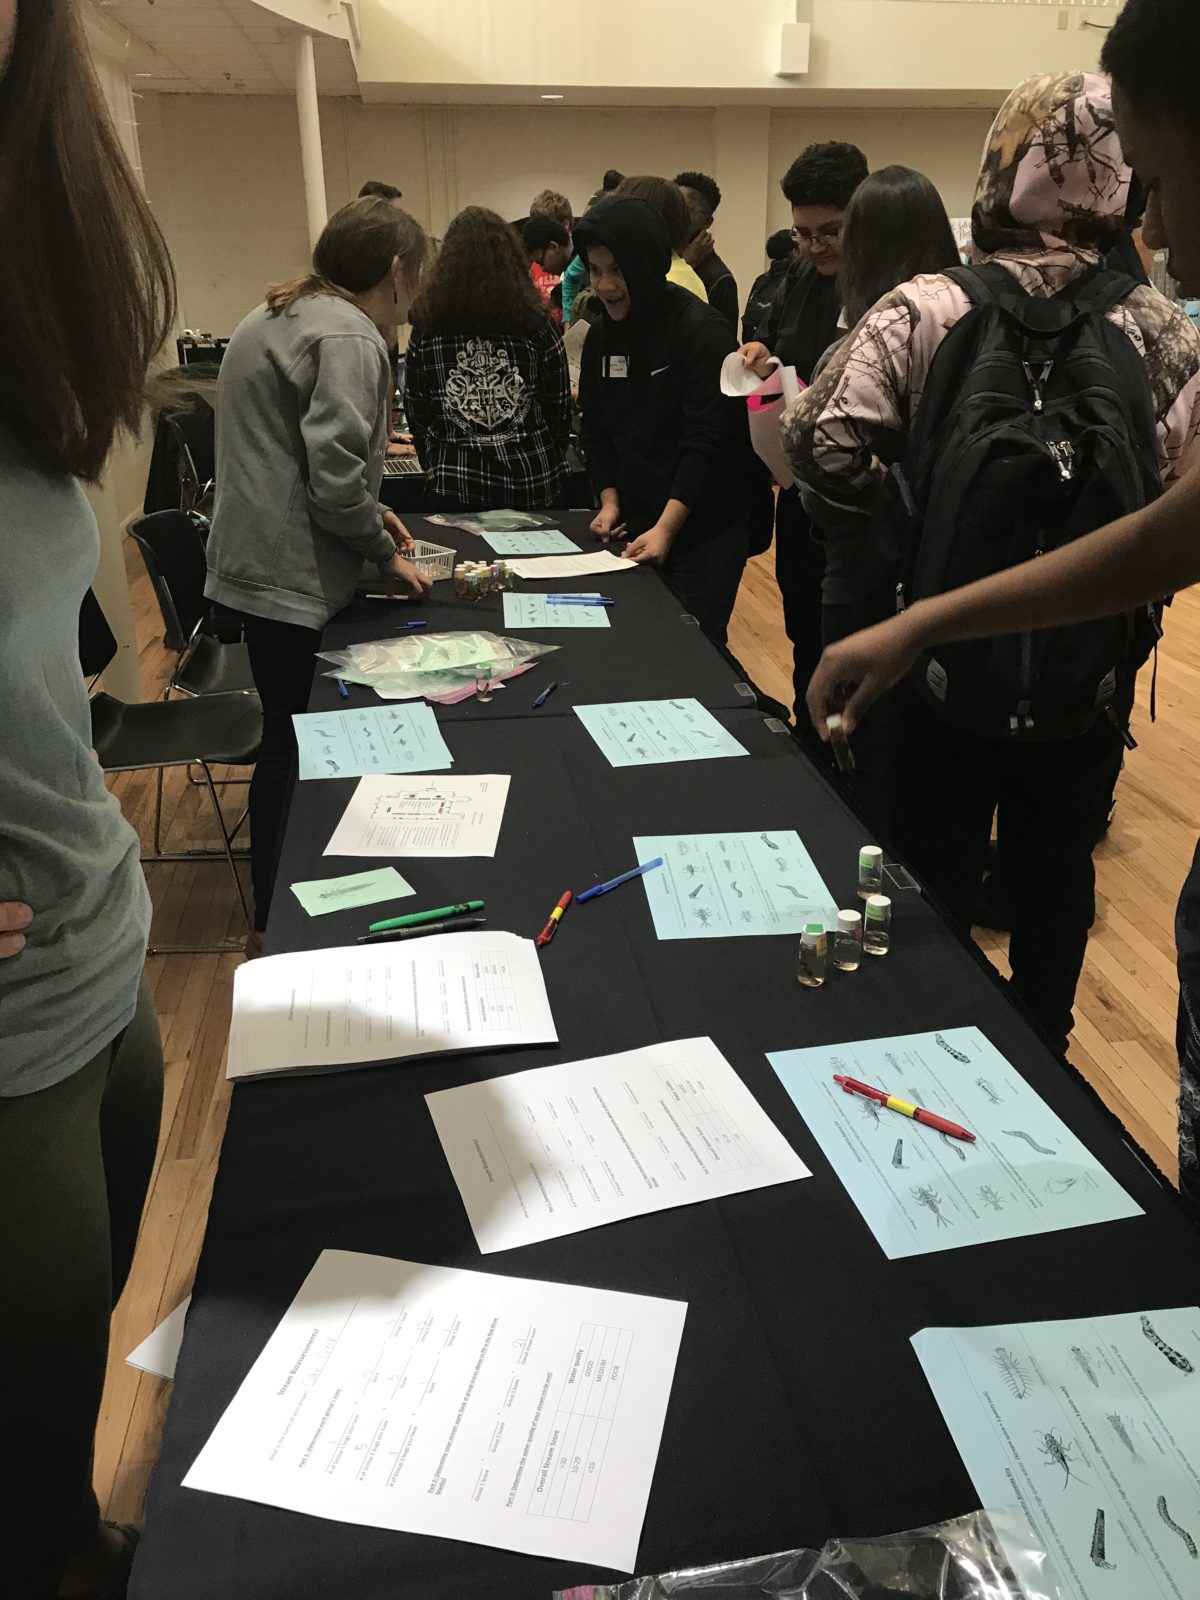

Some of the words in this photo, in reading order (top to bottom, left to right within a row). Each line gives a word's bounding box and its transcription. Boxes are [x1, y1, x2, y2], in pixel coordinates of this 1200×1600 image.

[572, 1348, 584, 1367] quality
[567, 1367, 579, 1384] Water
[584, 1360, 594, 1376] GOOD
[276, 1375, 294, 1395] Stream
[535, 1469, 549, 1492] Overall
[542, 1446, 555, 1469] Stream
[549, 1429, 560, 1446] Score
